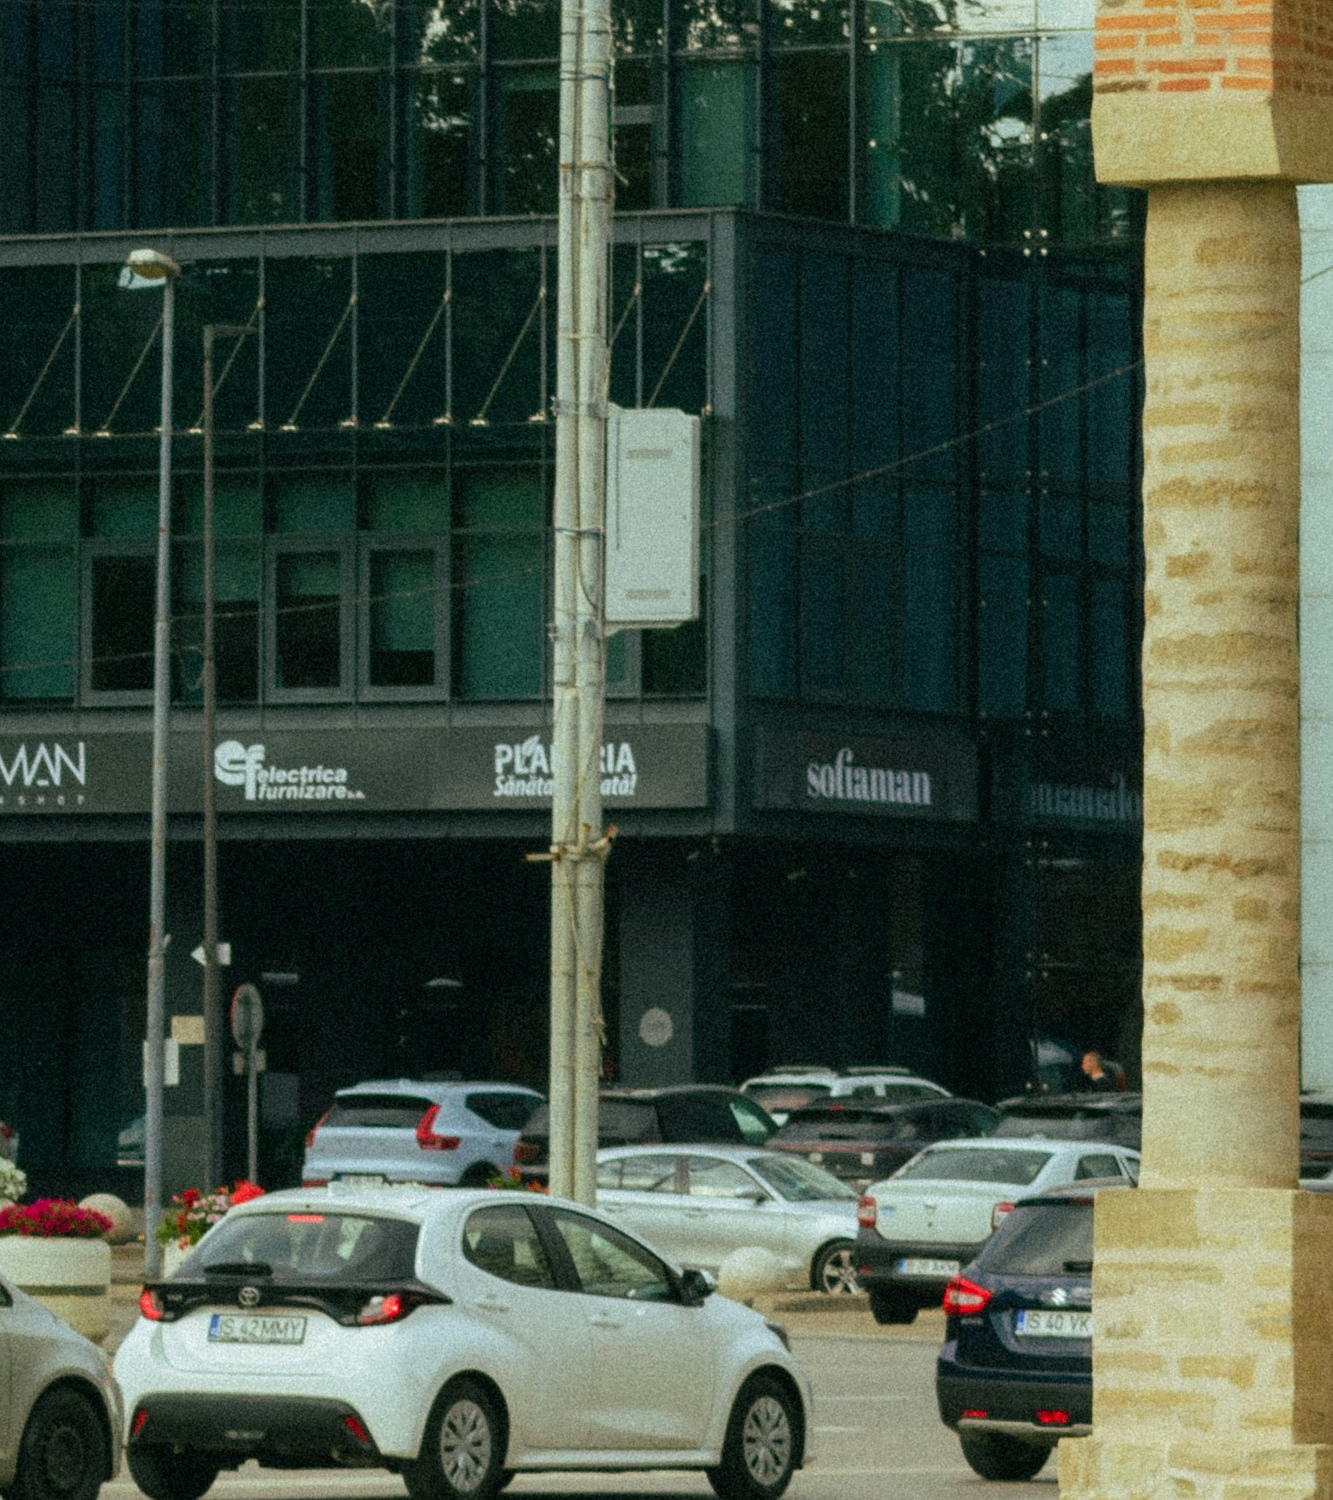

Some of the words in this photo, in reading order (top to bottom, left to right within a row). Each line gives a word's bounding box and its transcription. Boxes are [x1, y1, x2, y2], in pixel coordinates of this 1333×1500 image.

[256, 764, 348, 784] electrica
[807, 747, 932, 805] sofiaman
[257, 782, 347, 800] furnizare
